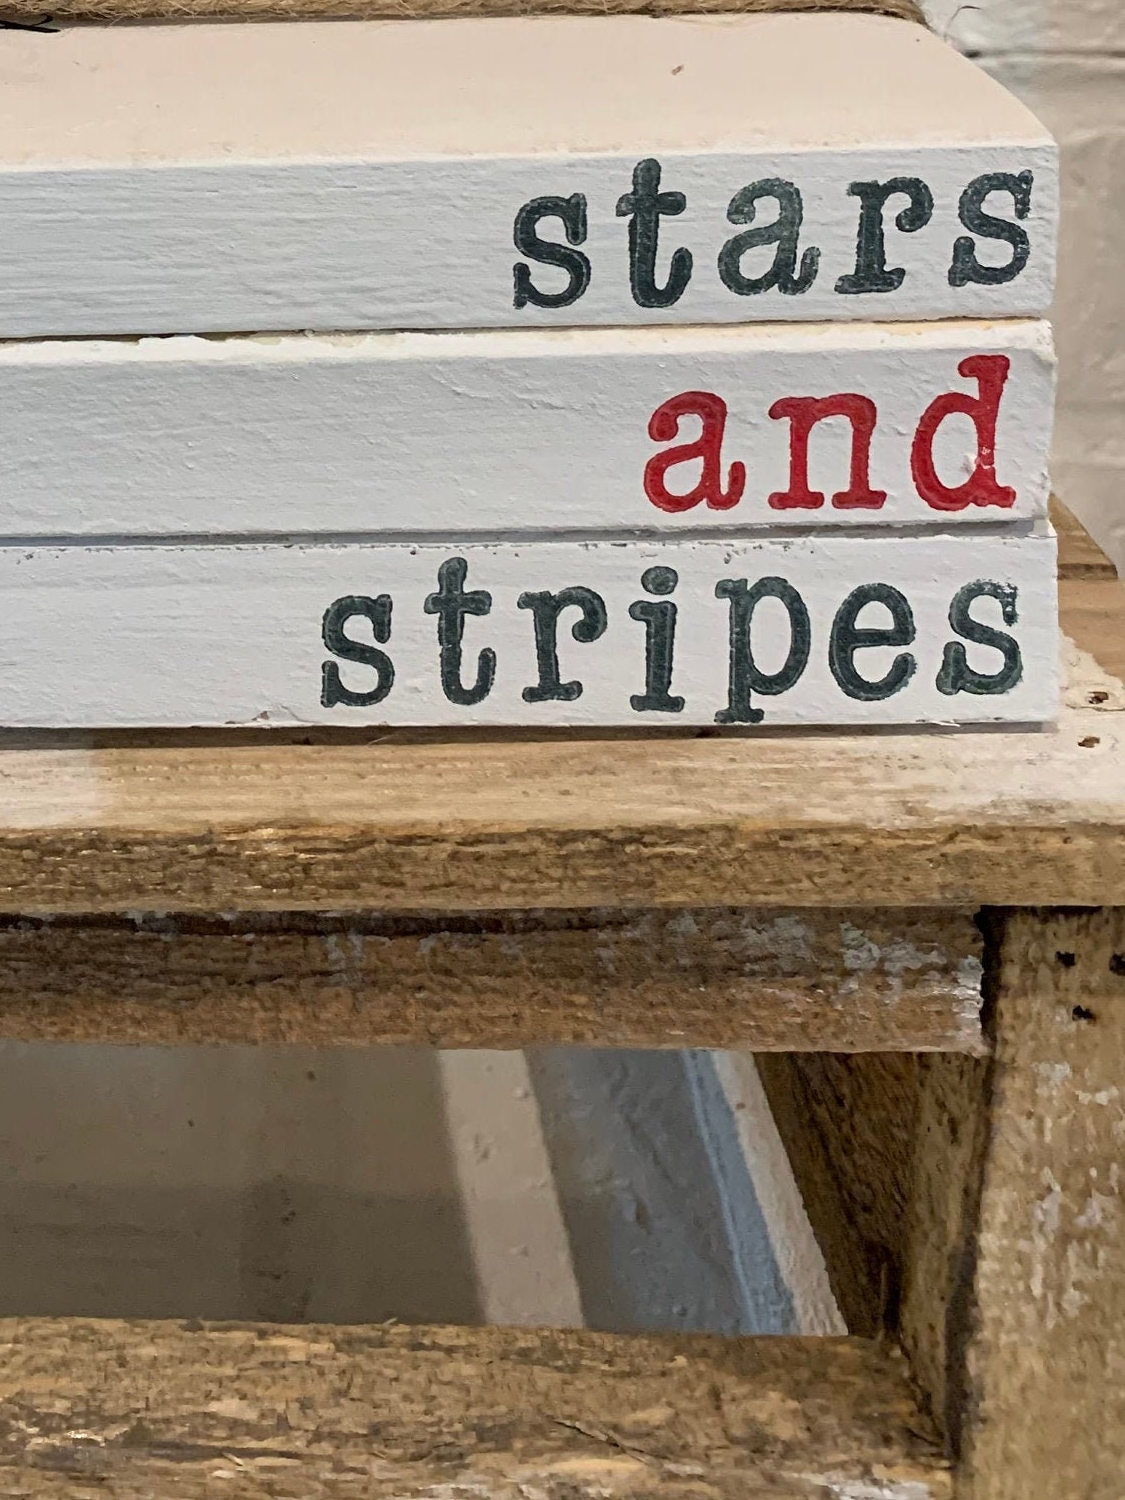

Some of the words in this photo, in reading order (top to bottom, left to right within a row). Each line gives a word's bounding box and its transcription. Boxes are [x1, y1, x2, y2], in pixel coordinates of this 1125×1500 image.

[513, 157, 1035, 310] stars
[643, 354, 1017, 514] and
[321, 556, 1024, 725] stripes
